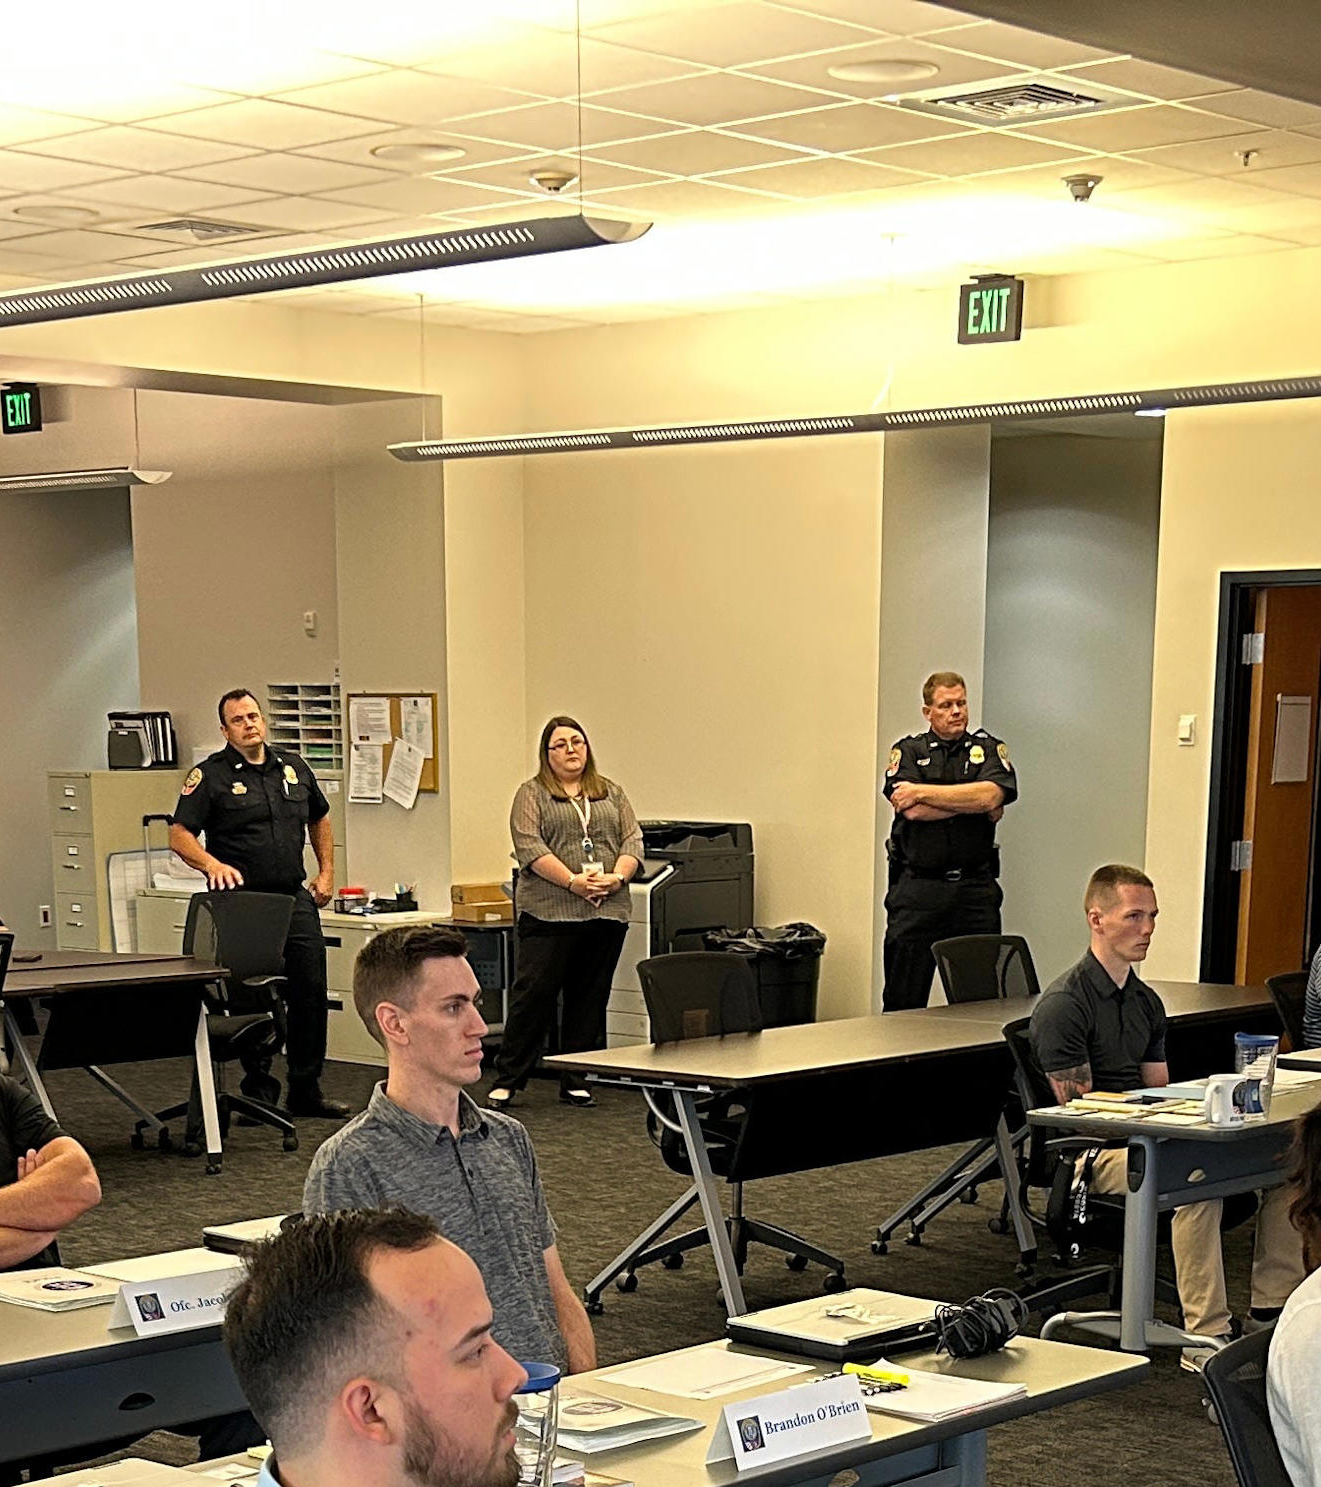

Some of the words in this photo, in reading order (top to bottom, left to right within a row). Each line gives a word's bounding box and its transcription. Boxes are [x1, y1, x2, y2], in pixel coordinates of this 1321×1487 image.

[967, 288, 1011, 335] EXIT
[5, 392, 31, 427] EXIT
[764, 1412, 815, 1435] Brandon
[816, 1400, 860, 1421] O'Brien
